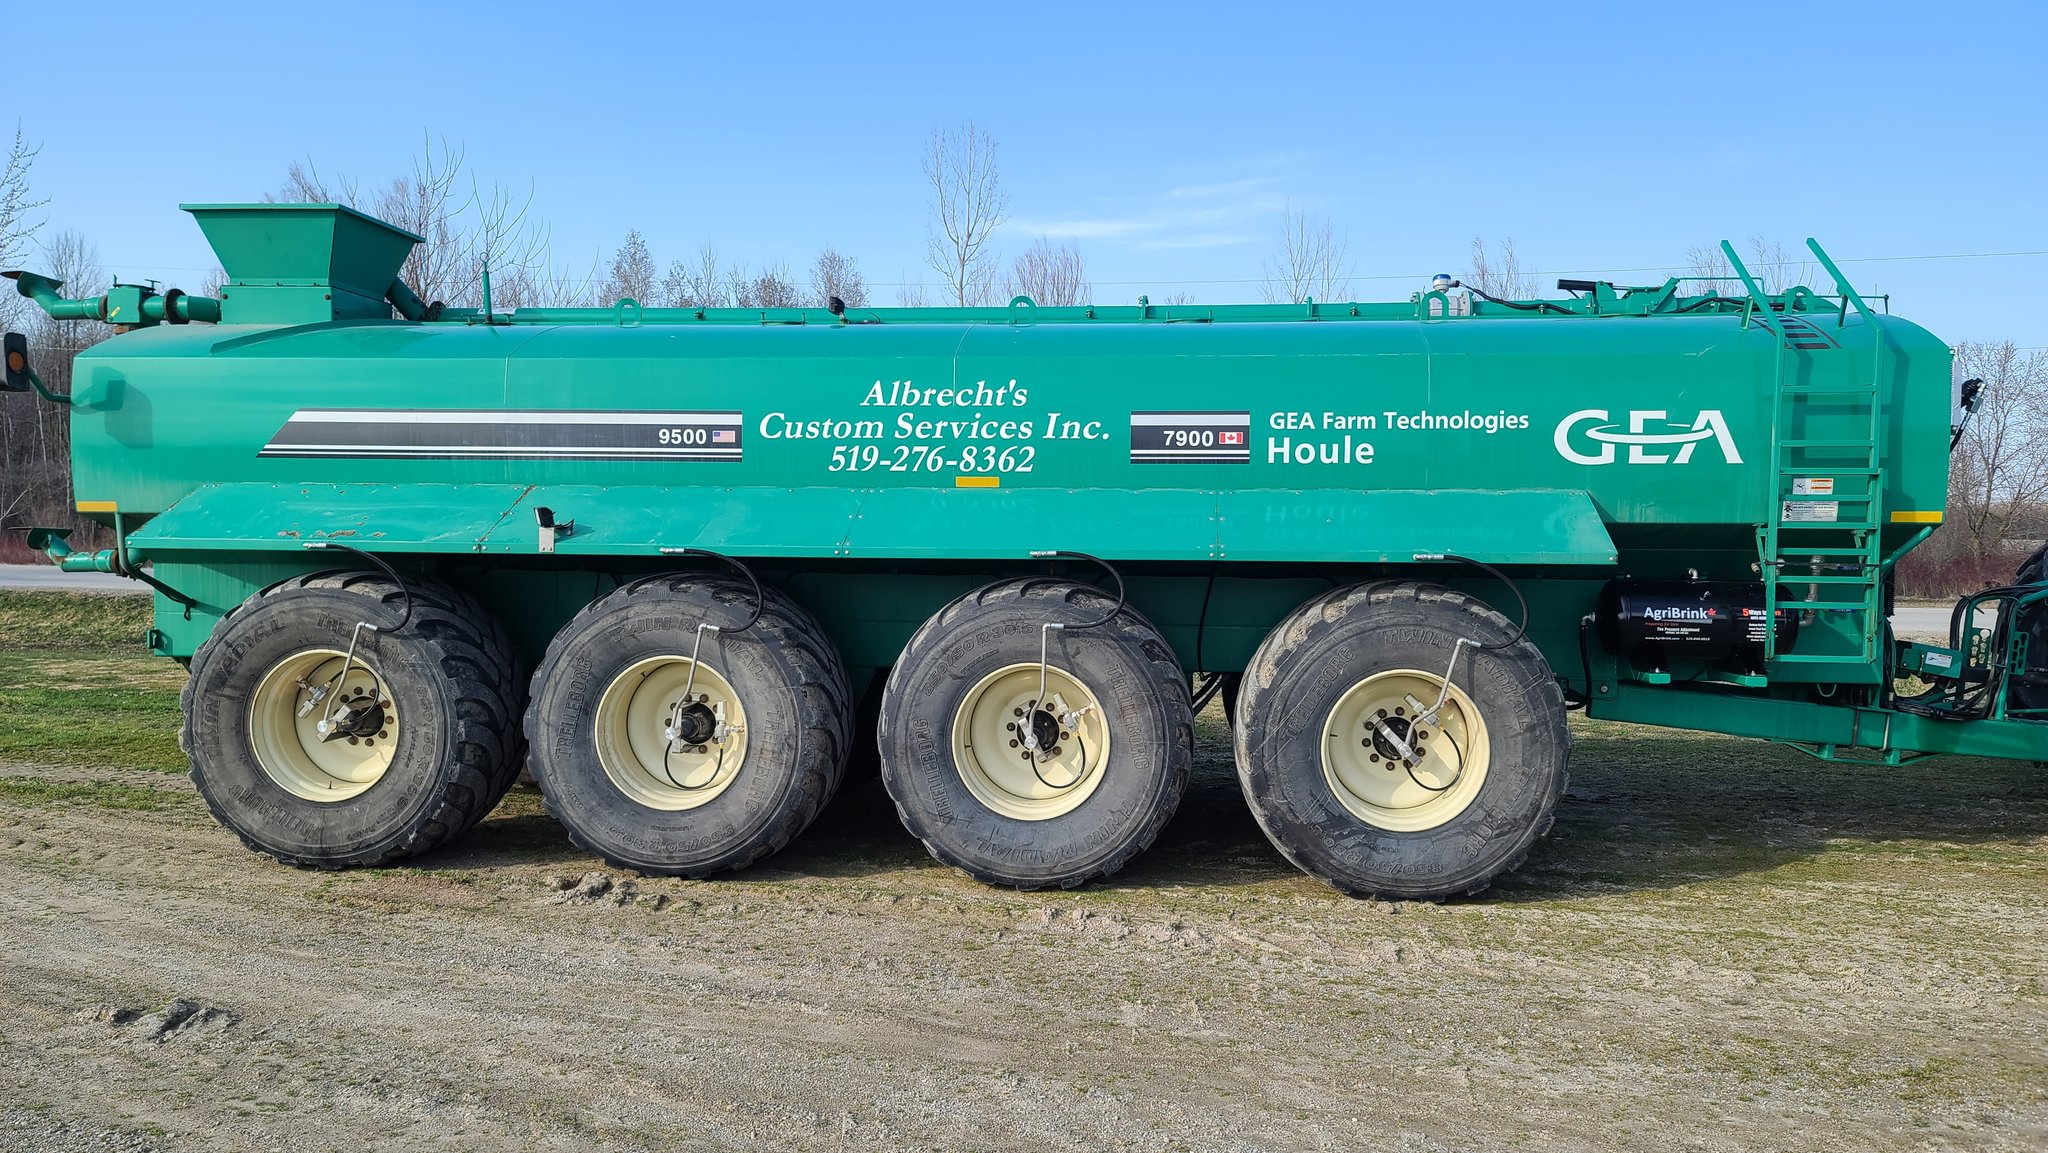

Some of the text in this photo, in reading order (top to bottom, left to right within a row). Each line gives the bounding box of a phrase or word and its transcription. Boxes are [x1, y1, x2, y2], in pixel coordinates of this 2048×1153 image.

[859, 379, 1028, 407] Albrecht's
[658, 428, 707, 445] 9500
[759, 412, 1109, 440] Custom Services Inc.
[1269, 411, 1529, 434] GEA Farm Technologies
[1163, 430, 1214, 447] 7900
[1268, 436, 1374, 464] Houle
[1553, 409, 1744, 465] GEA
[828, 445, 1035, 473] 519-276-8362
[1643, 606, 1708, 621] AgriBrink
[1380, 628, 1455, 651] TWIN
[1282, 645, 1355, 742] TRELLEBORG
[555, 657, 594, 760] TRELLEBORG
[1106, 663, 1150, 770] TRELLEBORG
[910, 718, 955, 824] TRELLEBORG
